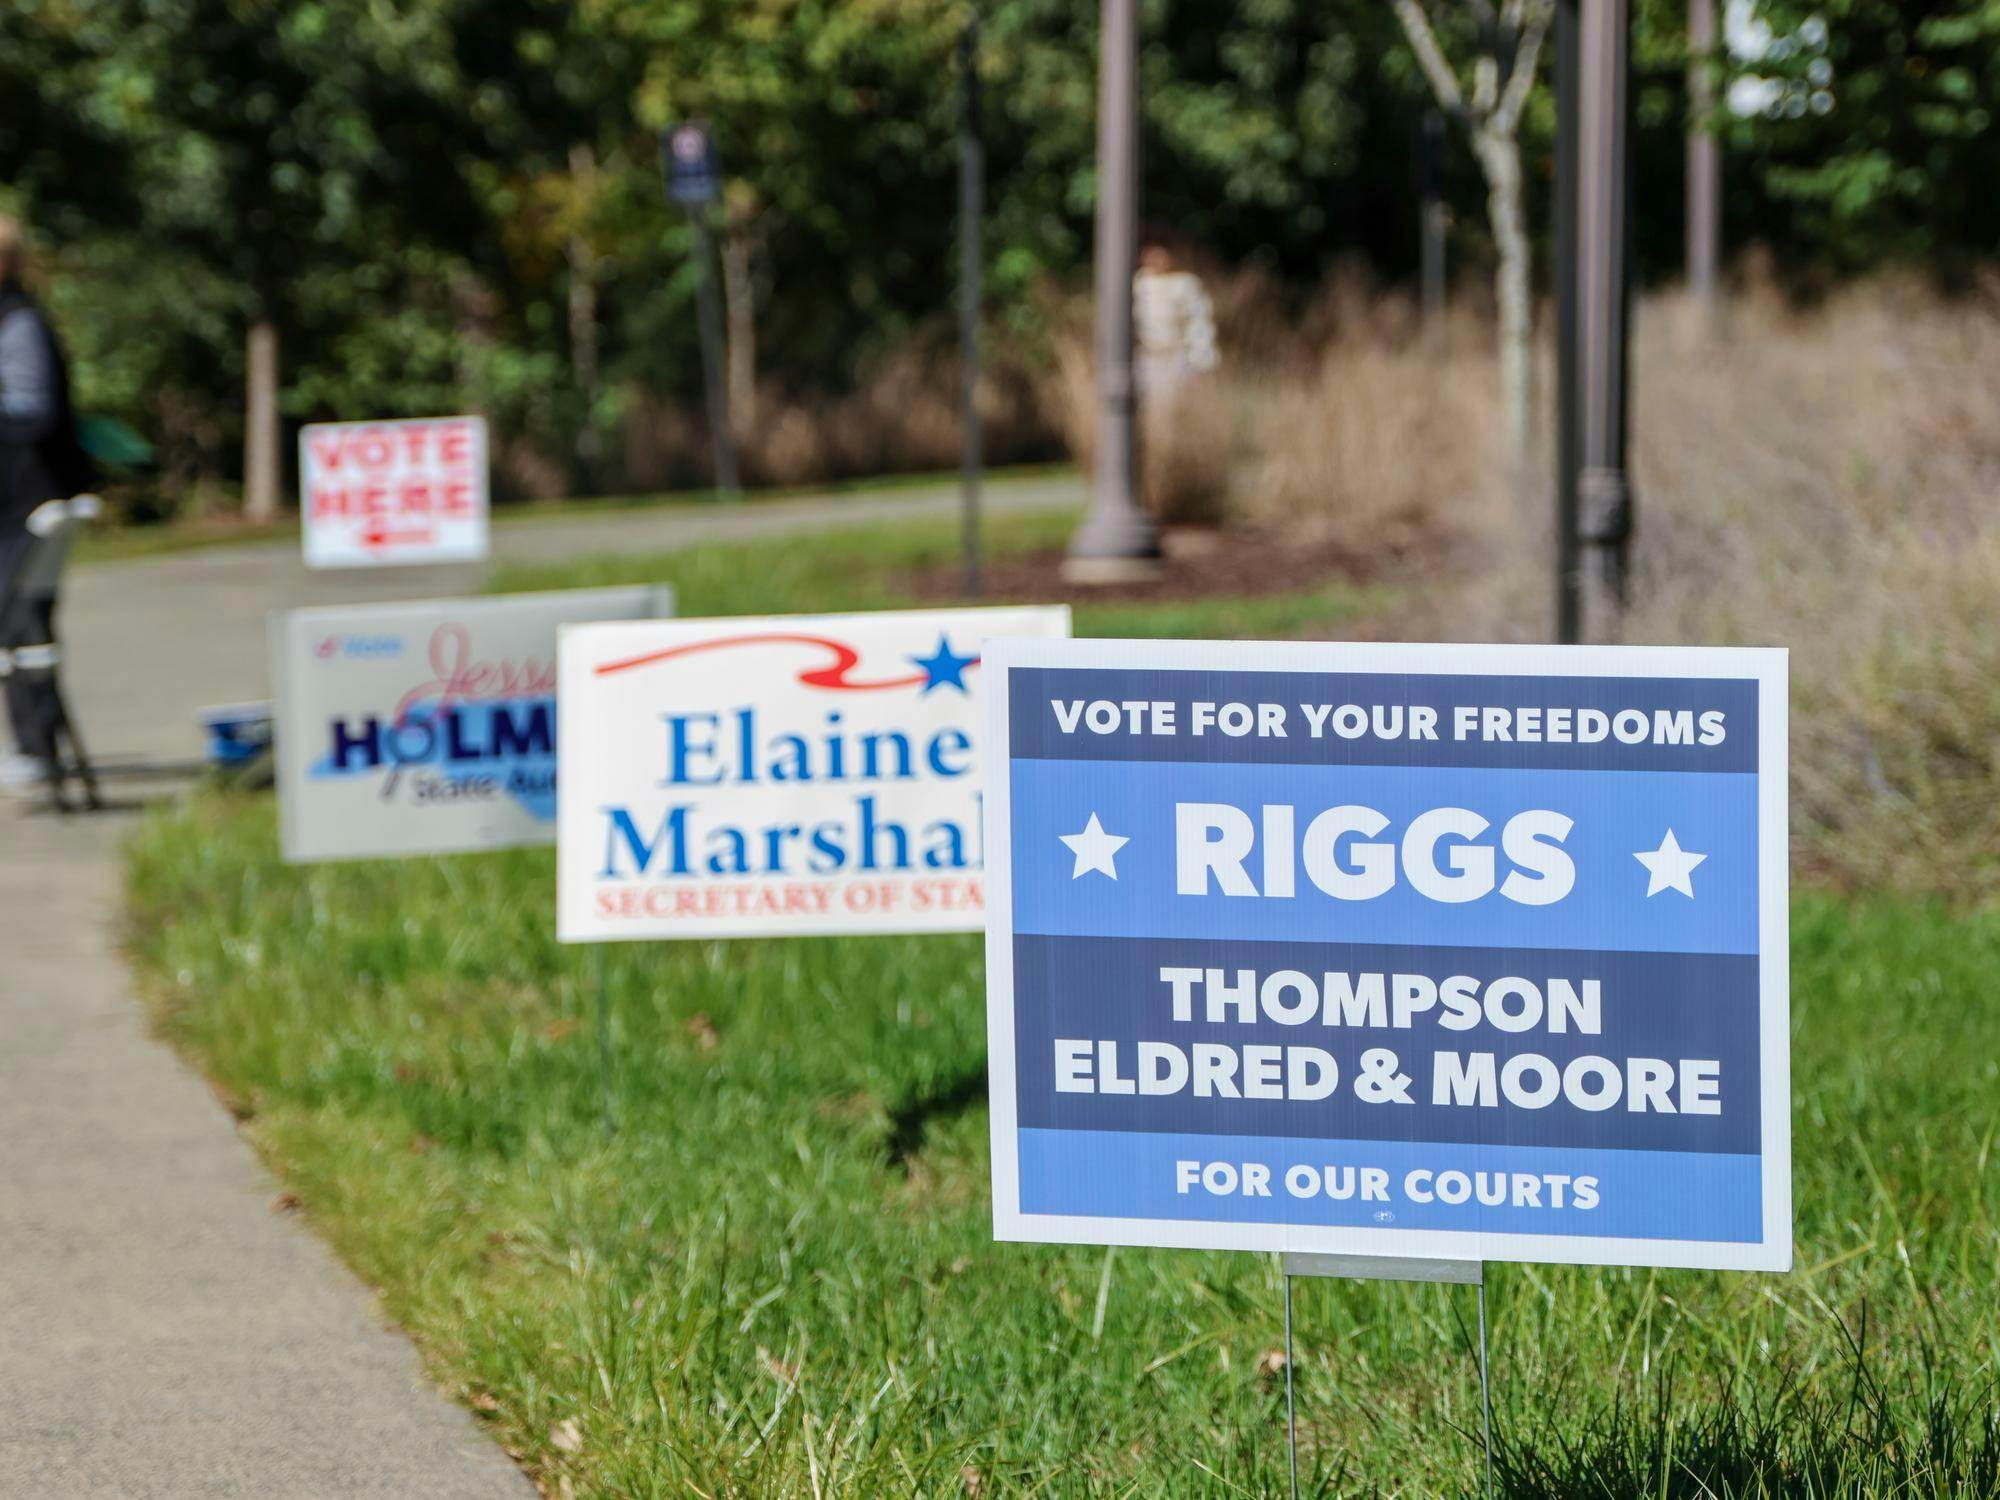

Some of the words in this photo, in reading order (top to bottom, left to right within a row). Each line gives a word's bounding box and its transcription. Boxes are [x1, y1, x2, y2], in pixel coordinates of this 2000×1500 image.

[310, 426, 473, 474] VOTE
[312, 477, 476, 524] HERE
[395, 621, 557, 726] Jess
[657, 706, 972, 787] Elaine
[1051, 700, 1176, 736] VOTE
[1192, 702, 1288, 739] FOR
[1301, 704, 1439, 741] YOUR
[1454, 707, 1726, 746] FREEDOMS
[412, 771, 498, 802] State
[1176, 802, 1576, 906] RIGGS
[596, 884, 836, 918] SECRETARY
[843, 880, 901, 913] OF
[1160, 967, 1602, 1035] THOMPSON
[1054, 1039, 1339, 1101] ELDRED
[1353, 1047, 1416, 1105] &
[1433, 1050, 1722, 1115] MOORE
[1176, 1160, 1272, 1198] FOR
[1285, 1164, 1391, 1203] OUR
[1404, 1168, 1600, 1211] COURTS
